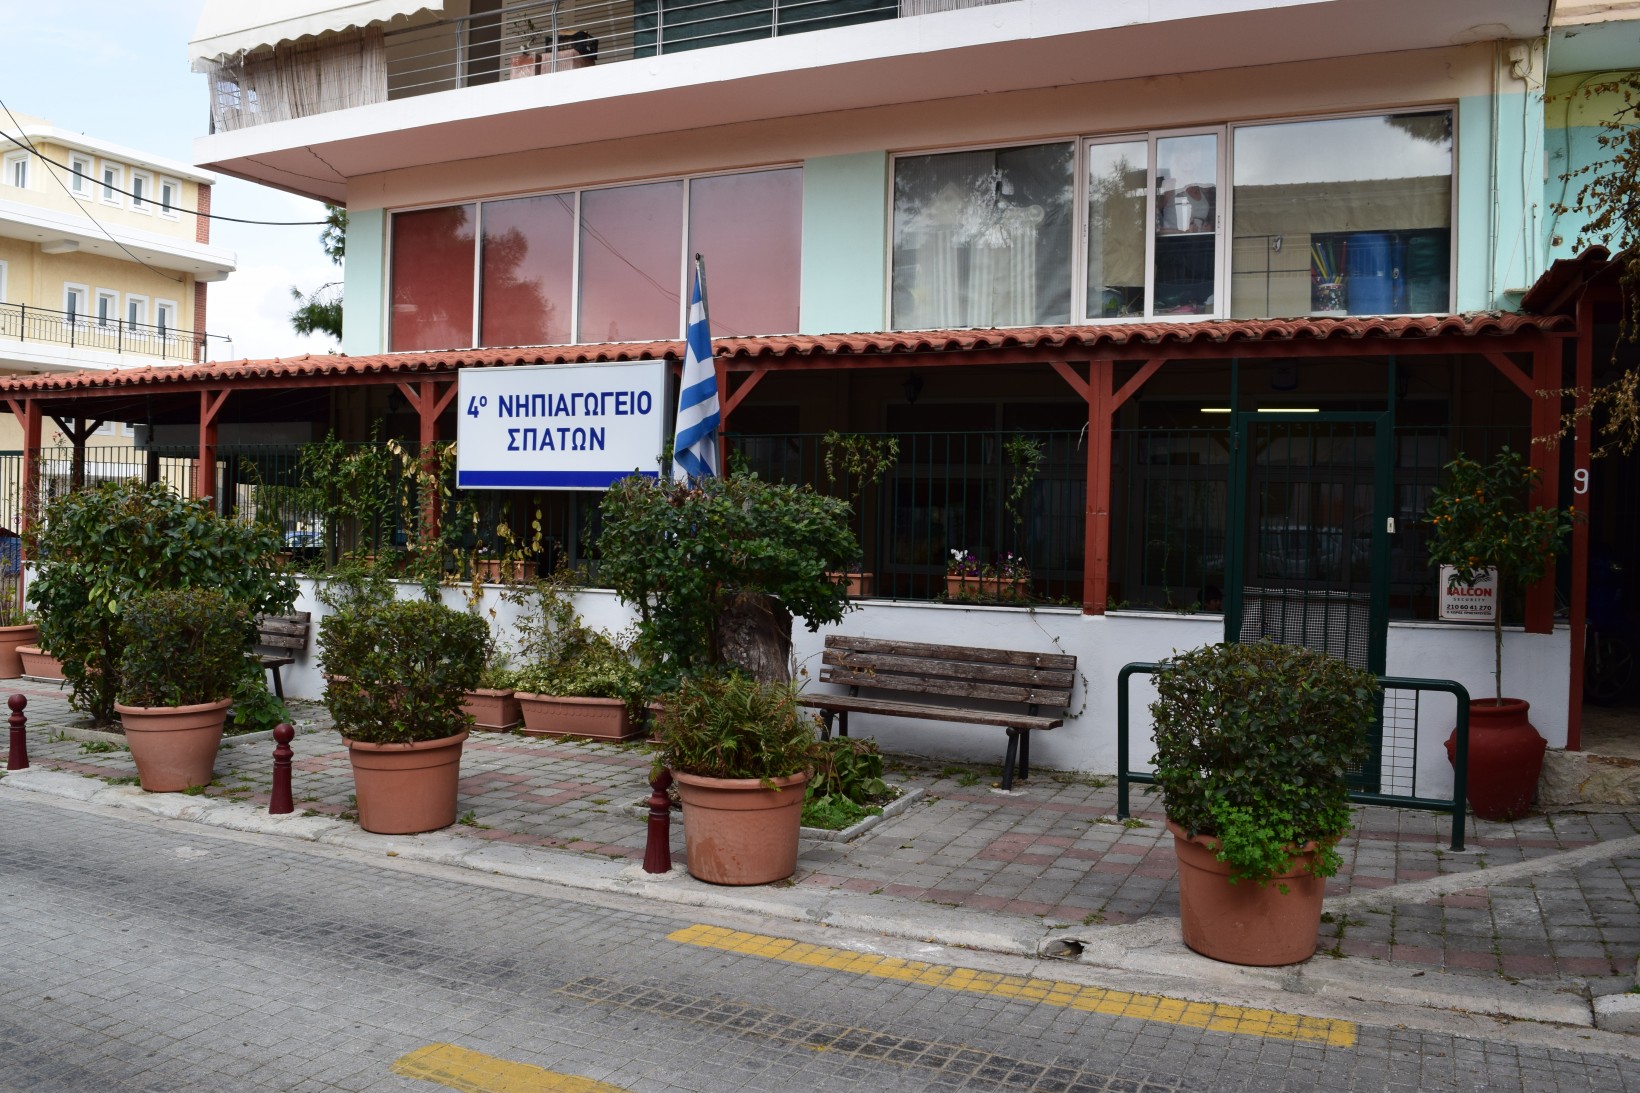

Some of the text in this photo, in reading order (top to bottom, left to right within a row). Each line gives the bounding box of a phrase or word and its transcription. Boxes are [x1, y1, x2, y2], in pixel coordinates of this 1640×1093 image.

[498, 390, 652, 418] ΝΗΠΙΑΓΩΓΕΙΟ
[507, 427, 606, 451] ΣΠΑΤΩΝ
[1574, 468, 1589, 494] 9
